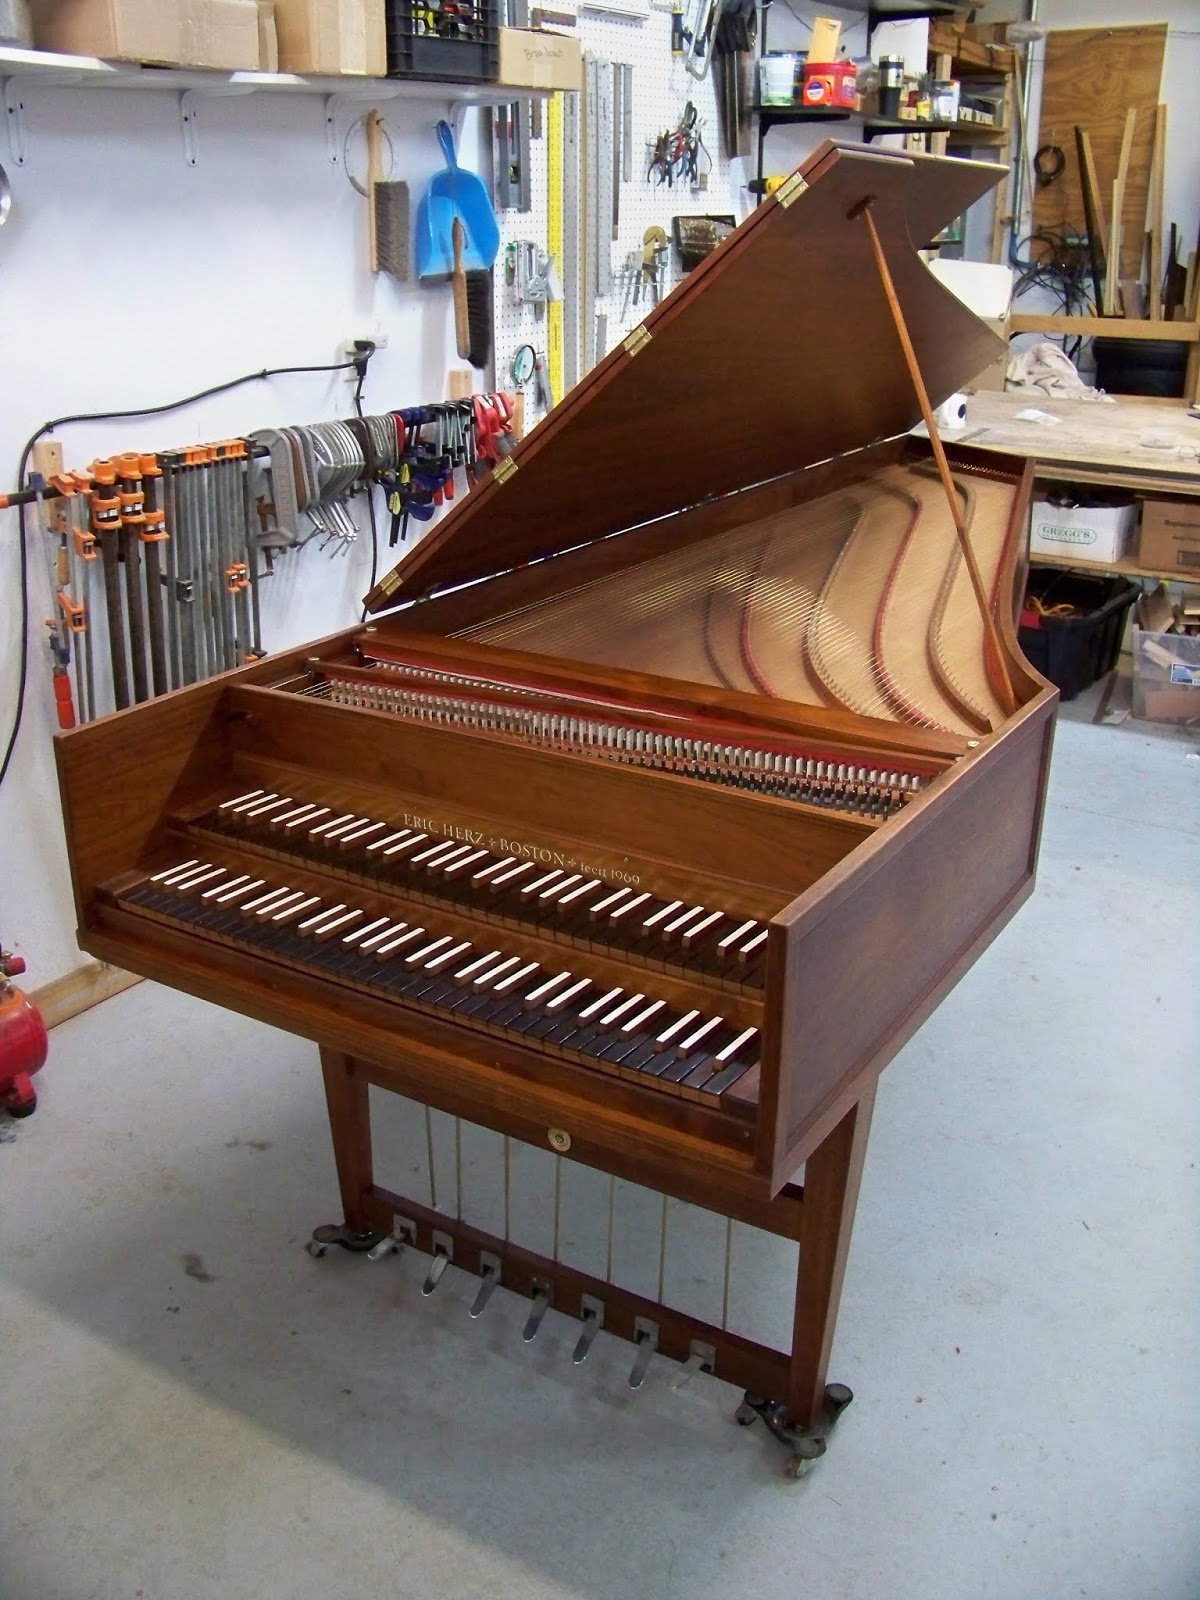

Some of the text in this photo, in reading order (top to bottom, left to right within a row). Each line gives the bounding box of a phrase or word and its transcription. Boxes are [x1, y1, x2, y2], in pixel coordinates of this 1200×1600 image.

[1042, 525, 1090, 539] GREGG'S
[403, 813, 439, 834] ERIC
[443, 823, 485, 846] HERZ
[500, 838, 565, 867] BOSTON
[610, 869, 640, 885] 1969
